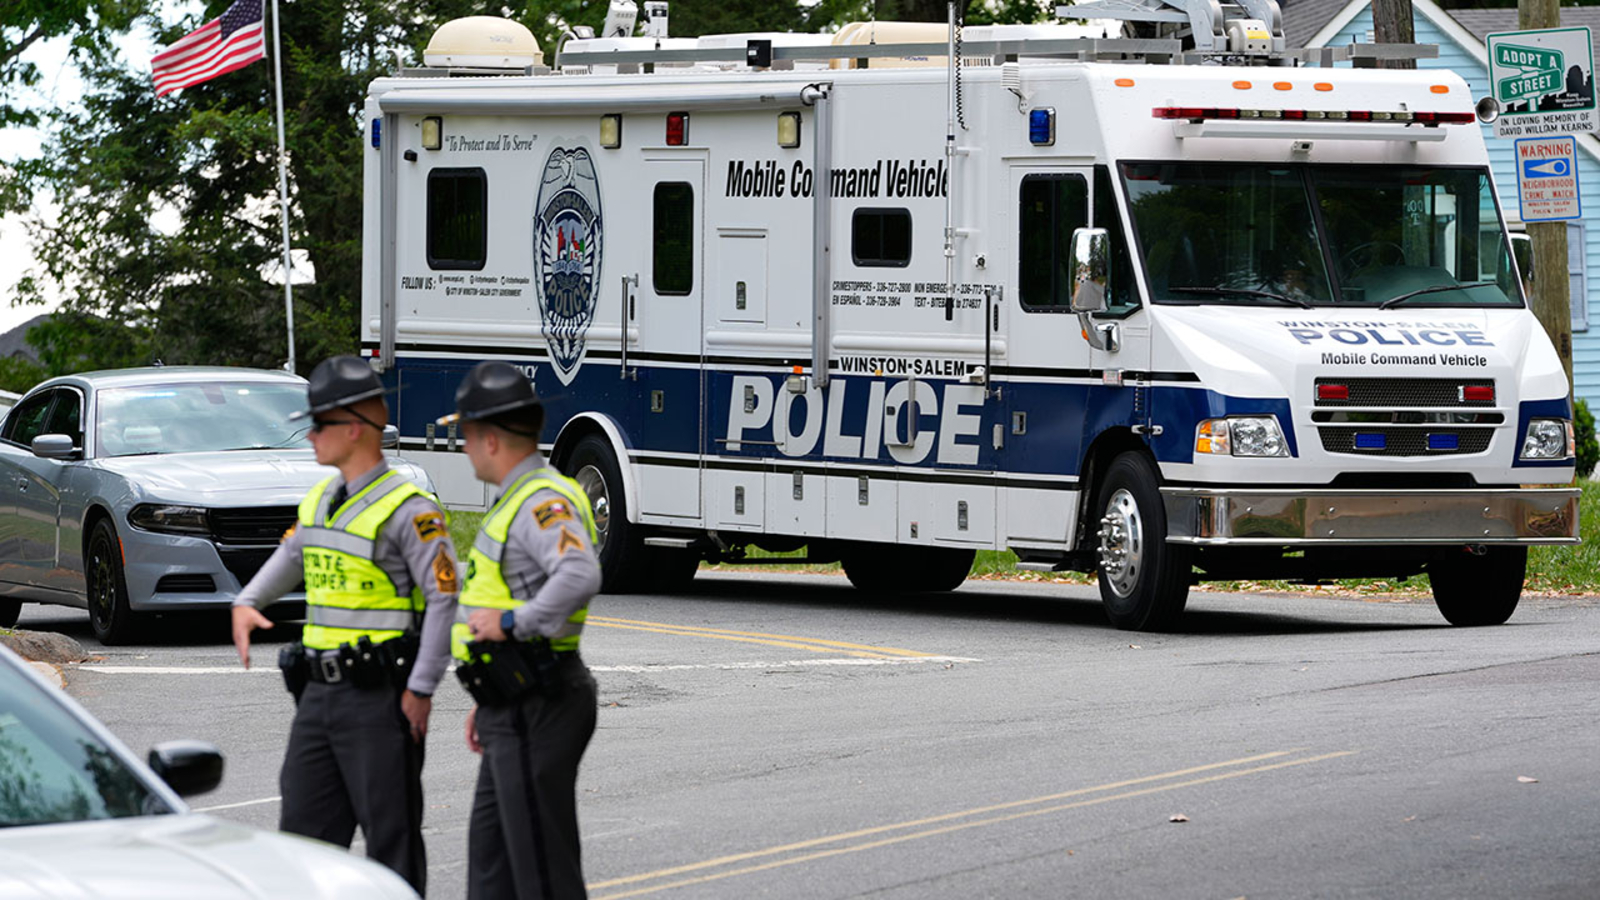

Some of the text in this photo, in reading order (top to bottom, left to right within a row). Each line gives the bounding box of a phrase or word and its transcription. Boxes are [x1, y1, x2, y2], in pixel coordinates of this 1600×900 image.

[1502, 50, 1557, 68] ADOPT A
[1510, 74, 1552, 95] STREET
[1500, 112, 1590, 126] IN LOVING MEMORY OF
[1500, 122, 1594, 136] DAVID WILLIAM KEARNS
[459, 135, 484, 151] Protect
[485, 134, 501, 151] and
[502, 135, 512, 151] To
[1519, 142, 1572, 157] WARNING
[725, 160, 786, 198] Mobile
[790, 160, 882, 198] Comand
[1522, 178, 1574, 190] NEIGHBORHOOD
[1524, 190, 1574, 200] CRIME WATCH
[401, 276, 423, 289] FOLLOW
[832, 281, 872, 291] CRIMESTOPPERS
[914, 283, 925, 293] NON
[926, 283, 956, 294] EMERGEY
[547, 277, 589, 317] POLICE
[832, 295, 839, 305] EN
[840, 292, 861, 305] ESPAÑOL
[914, 297, 926, 307] TEXT
[931, 297, 954, 308] BITEB
[1278, 320, 1480, 330] WINSTON-SALEM
[1288, 328, 1495, 348] POLICE
[840, 356, 965, 377] WINSTON-SALEM
[1321, 353, 1487, 367] Mobile Command Vehicle
[725, 375, 986, 465] POLICE
